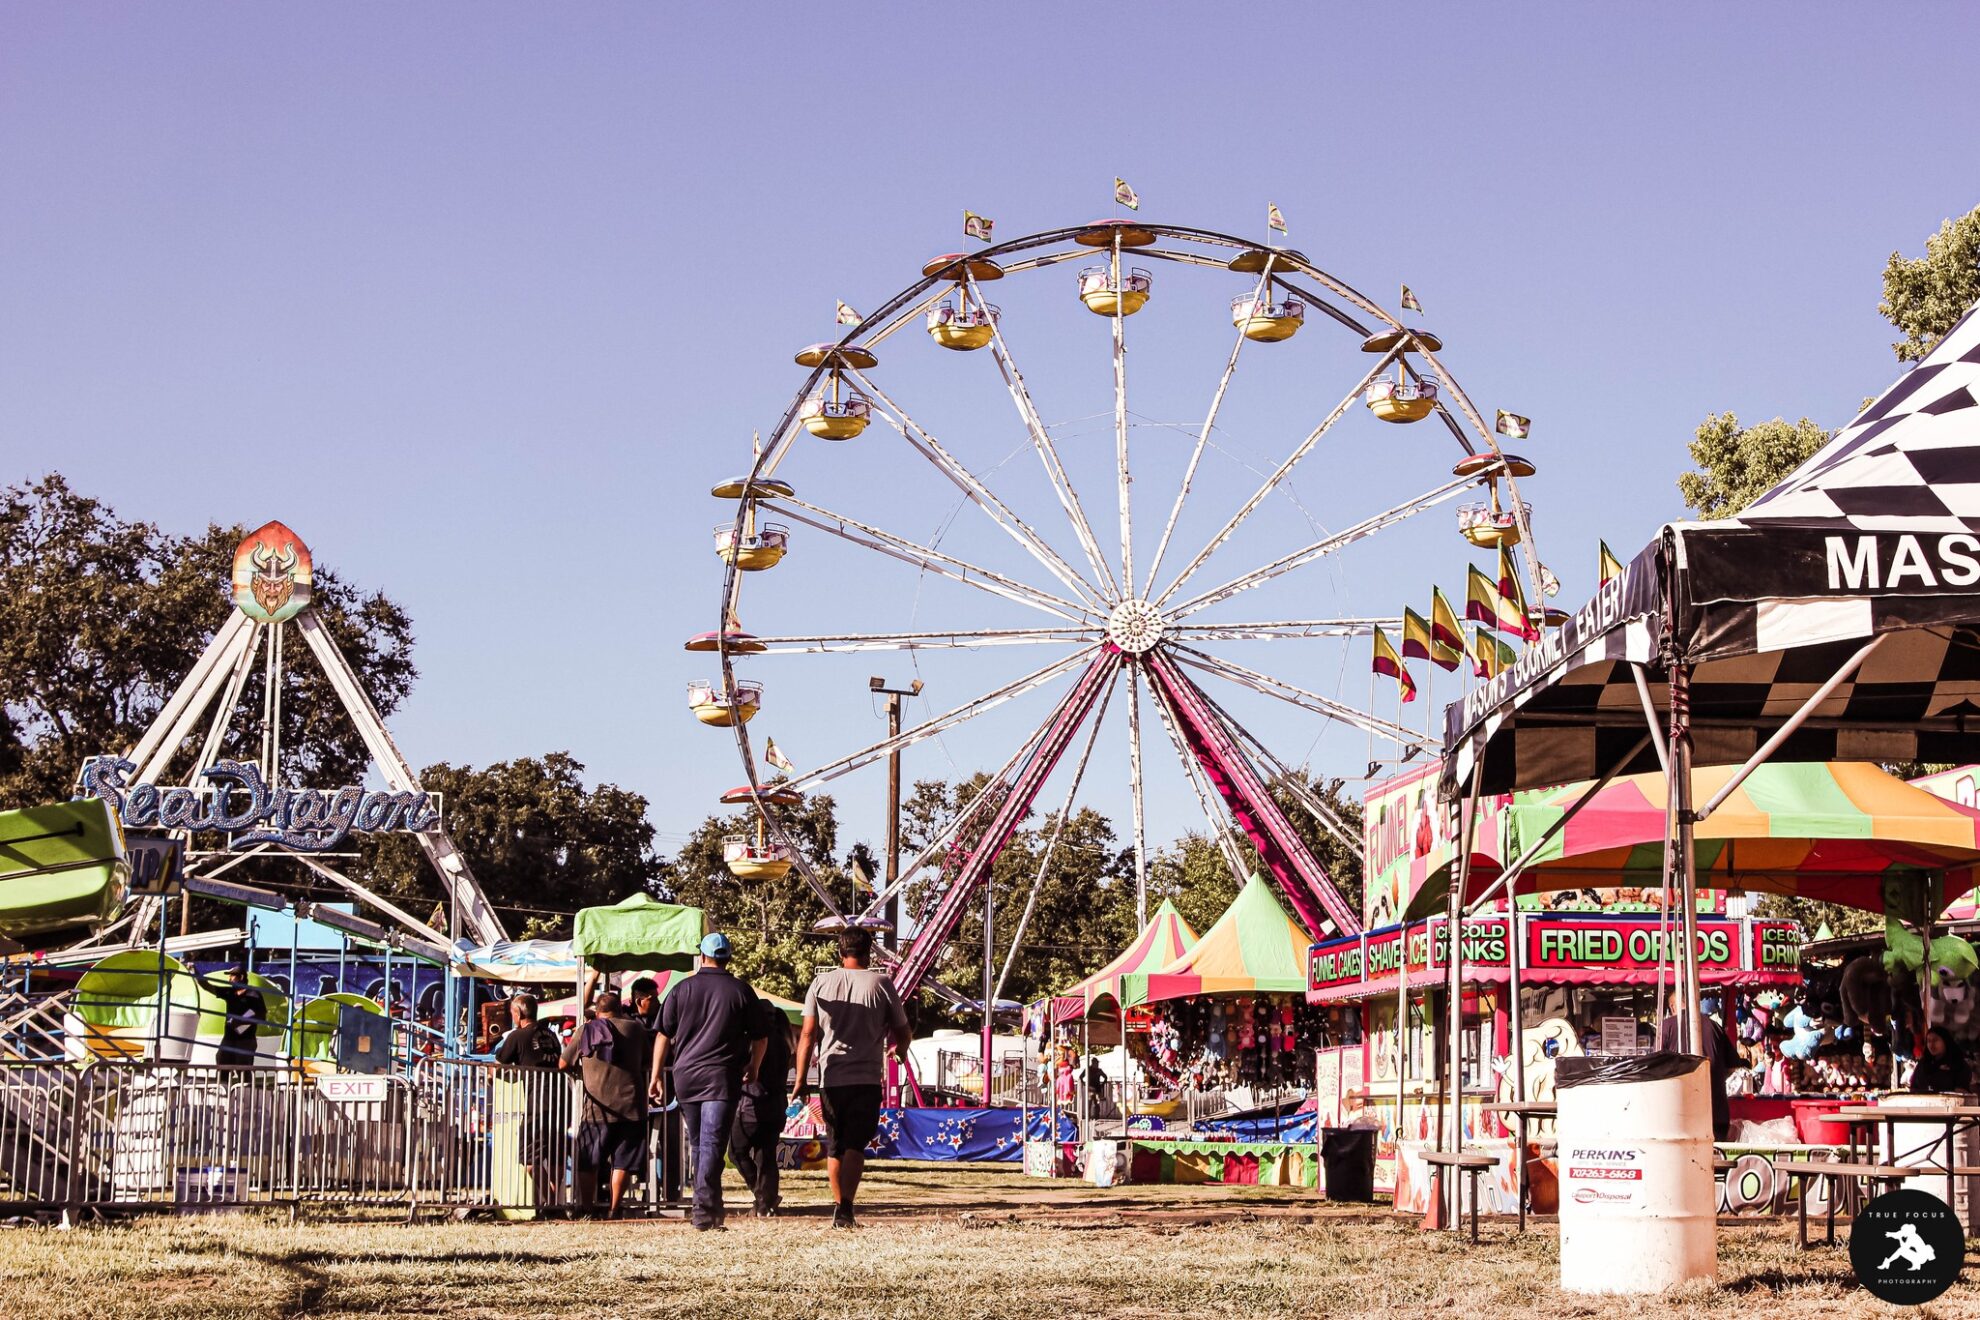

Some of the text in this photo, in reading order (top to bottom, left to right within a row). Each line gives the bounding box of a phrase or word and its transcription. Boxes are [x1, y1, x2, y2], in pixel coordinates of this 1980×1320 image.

[1825, 534, 1980, 589] MAS
[1576, 564, 1632, 644] EATERY
[80, 754, 441, 851] Sea Dragon
[1435, 939, 1506, 961] DNKS
[1541, 928, 1623, 961] FRIED
[1762, 928, 1785, 941] ICE
[1312, 946, 1362, 983] FUNNEL CAKES
[1368, 932, 1427, 974] SHAVE ICE
[329, 1082, 375, 1095] EXIT
[1571, 1149, 1636, 1161] PERKINS
[1599, 1191, 1632, 1200] Disposal
